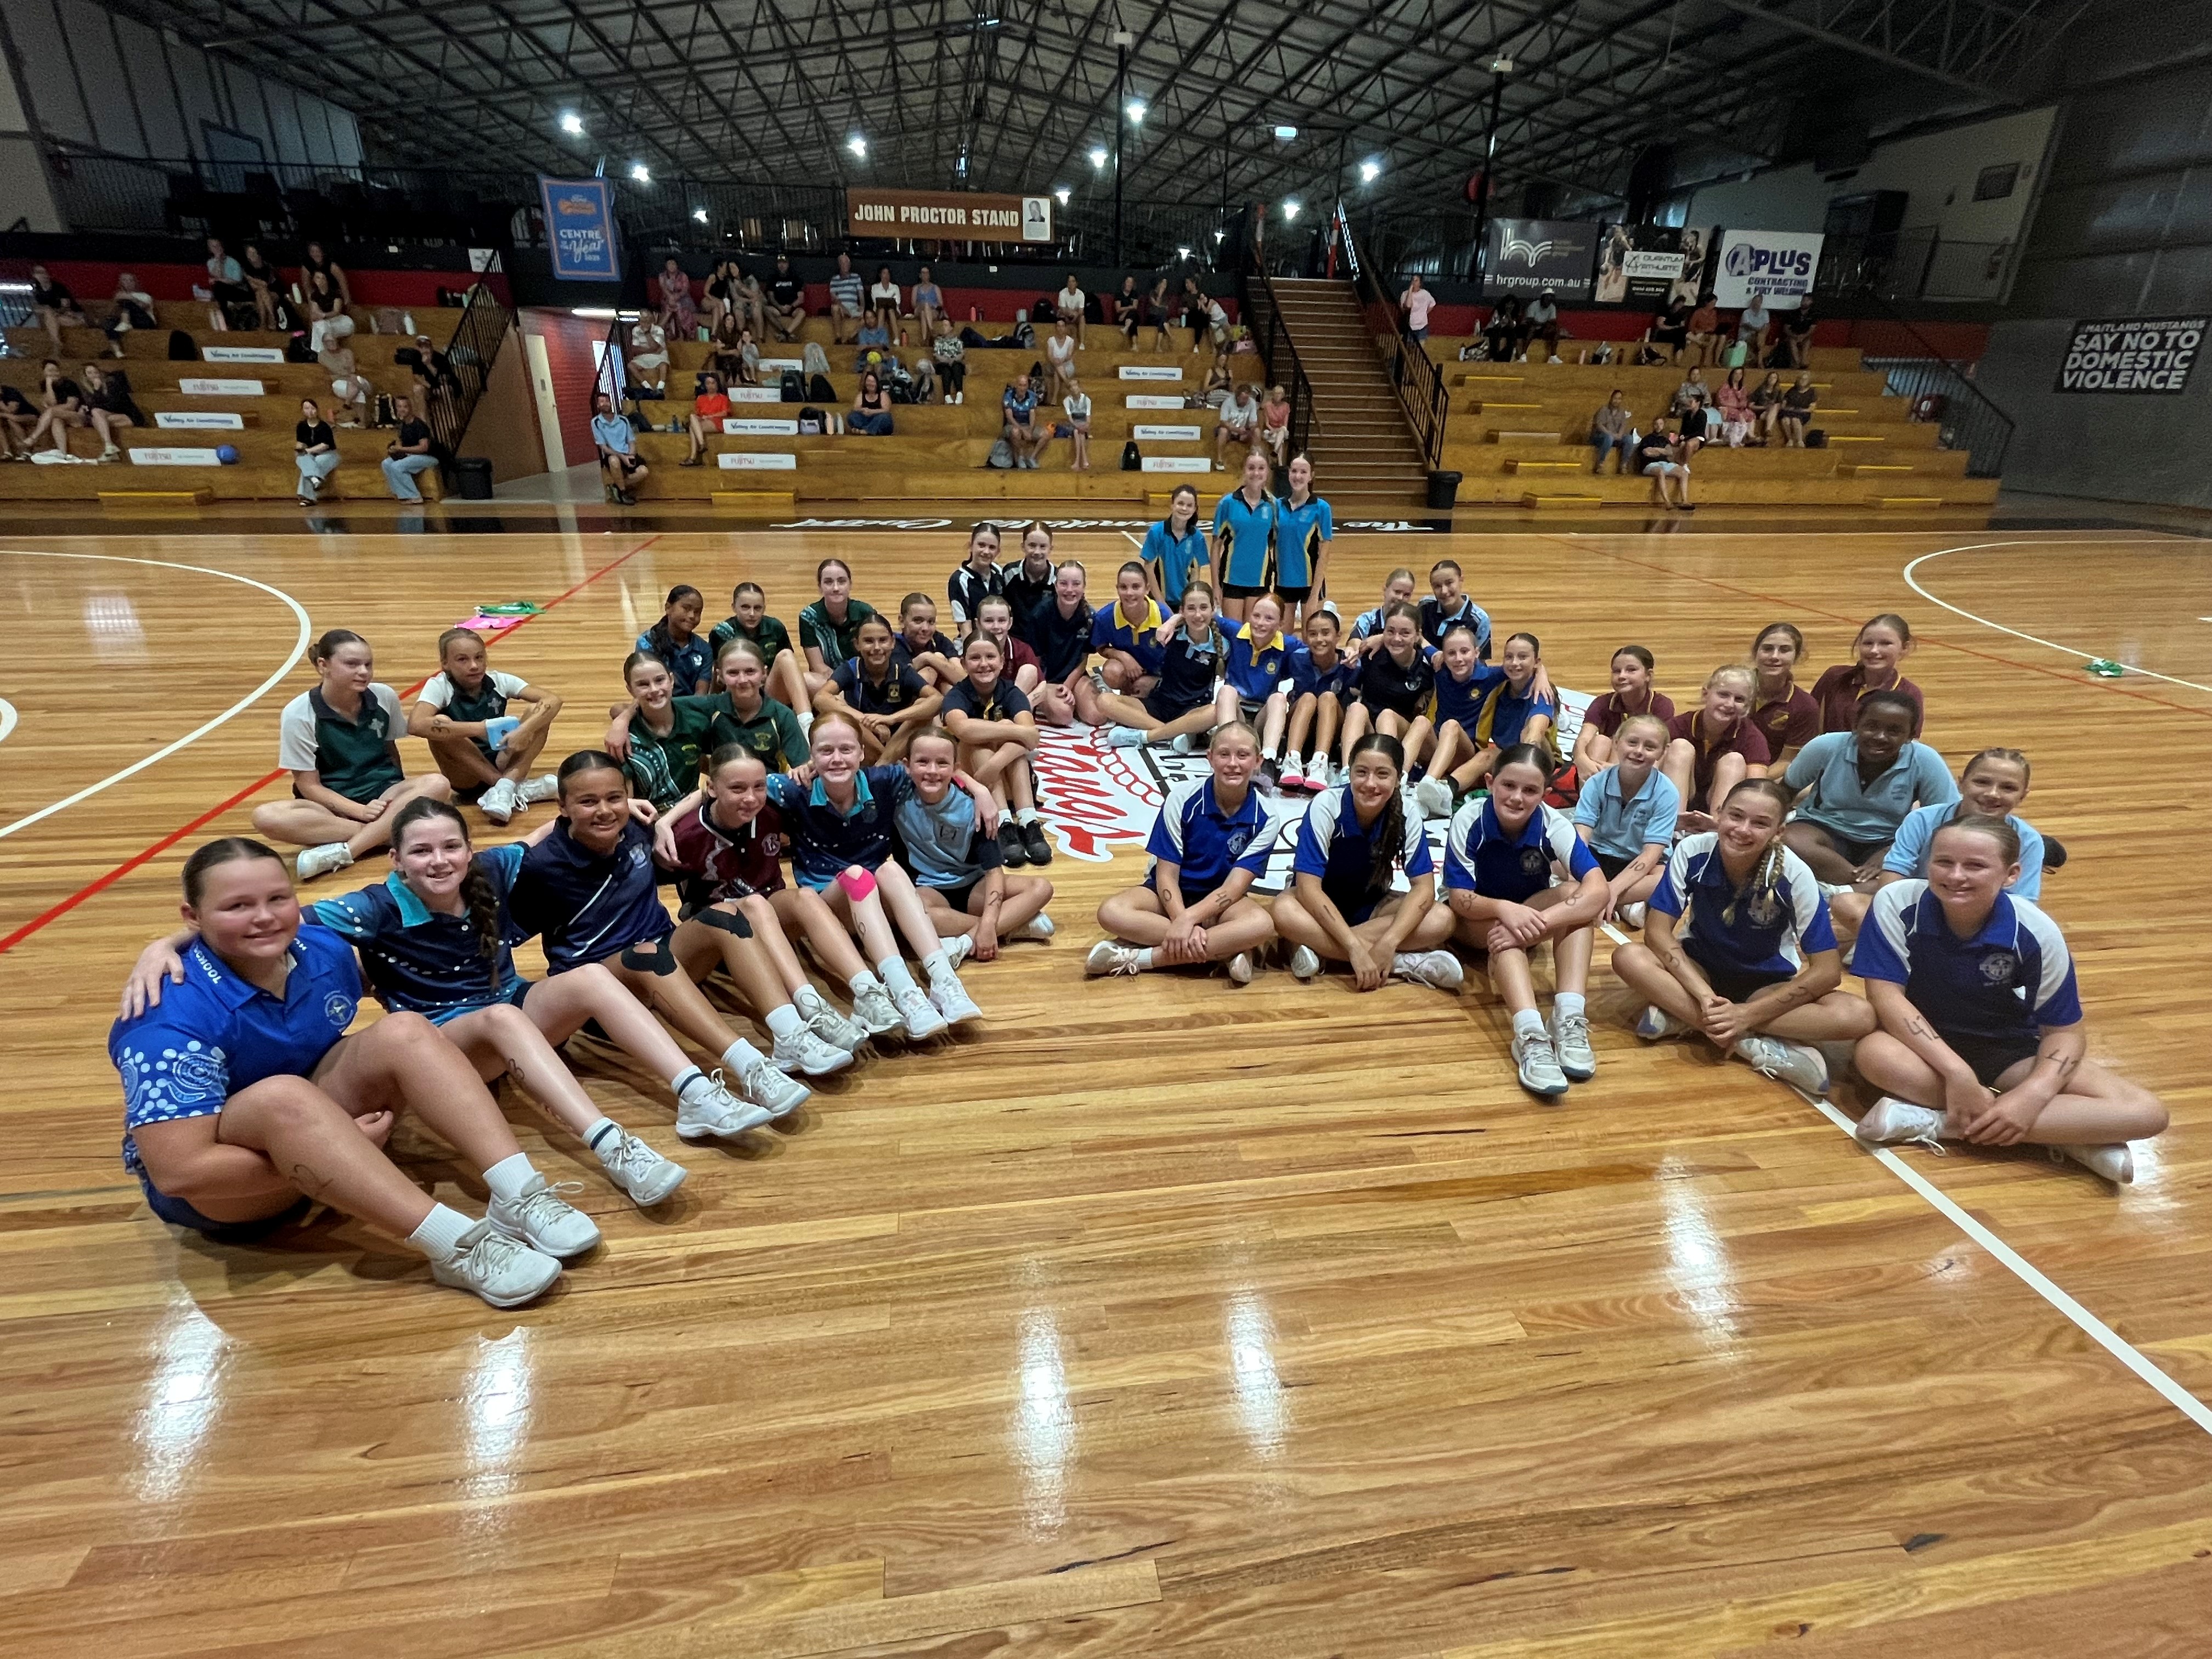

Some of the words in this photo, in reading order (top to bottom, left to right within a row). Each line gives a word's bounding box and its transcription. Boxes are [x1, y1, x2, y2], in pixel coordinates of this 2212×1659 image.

[855, 204, 895, 222] JOHN
[900, 206, 966, 225] PROCTOR
[972, 209, 1019, 227] STAND
[560, 228, 602, 239] CENTRE
[569, 239, 605, 263] Year
[1496, 274, 1581, 289] hrgroup.com.au
[2085, 322, 2141, 332] MAITLAND
[2142, 320, 2206, 330] MUSTANGS
[2072, 332, 2120, 352] SAY
[2121, 331, 2160, 351] NO
[2164, 330, 2200, 349] TO
[2064, 349, 2194, 369] DOMESTIC
[2063, 369, 2186, 389] VIOLENCE
[1629, 860, 1646, 871] 10
